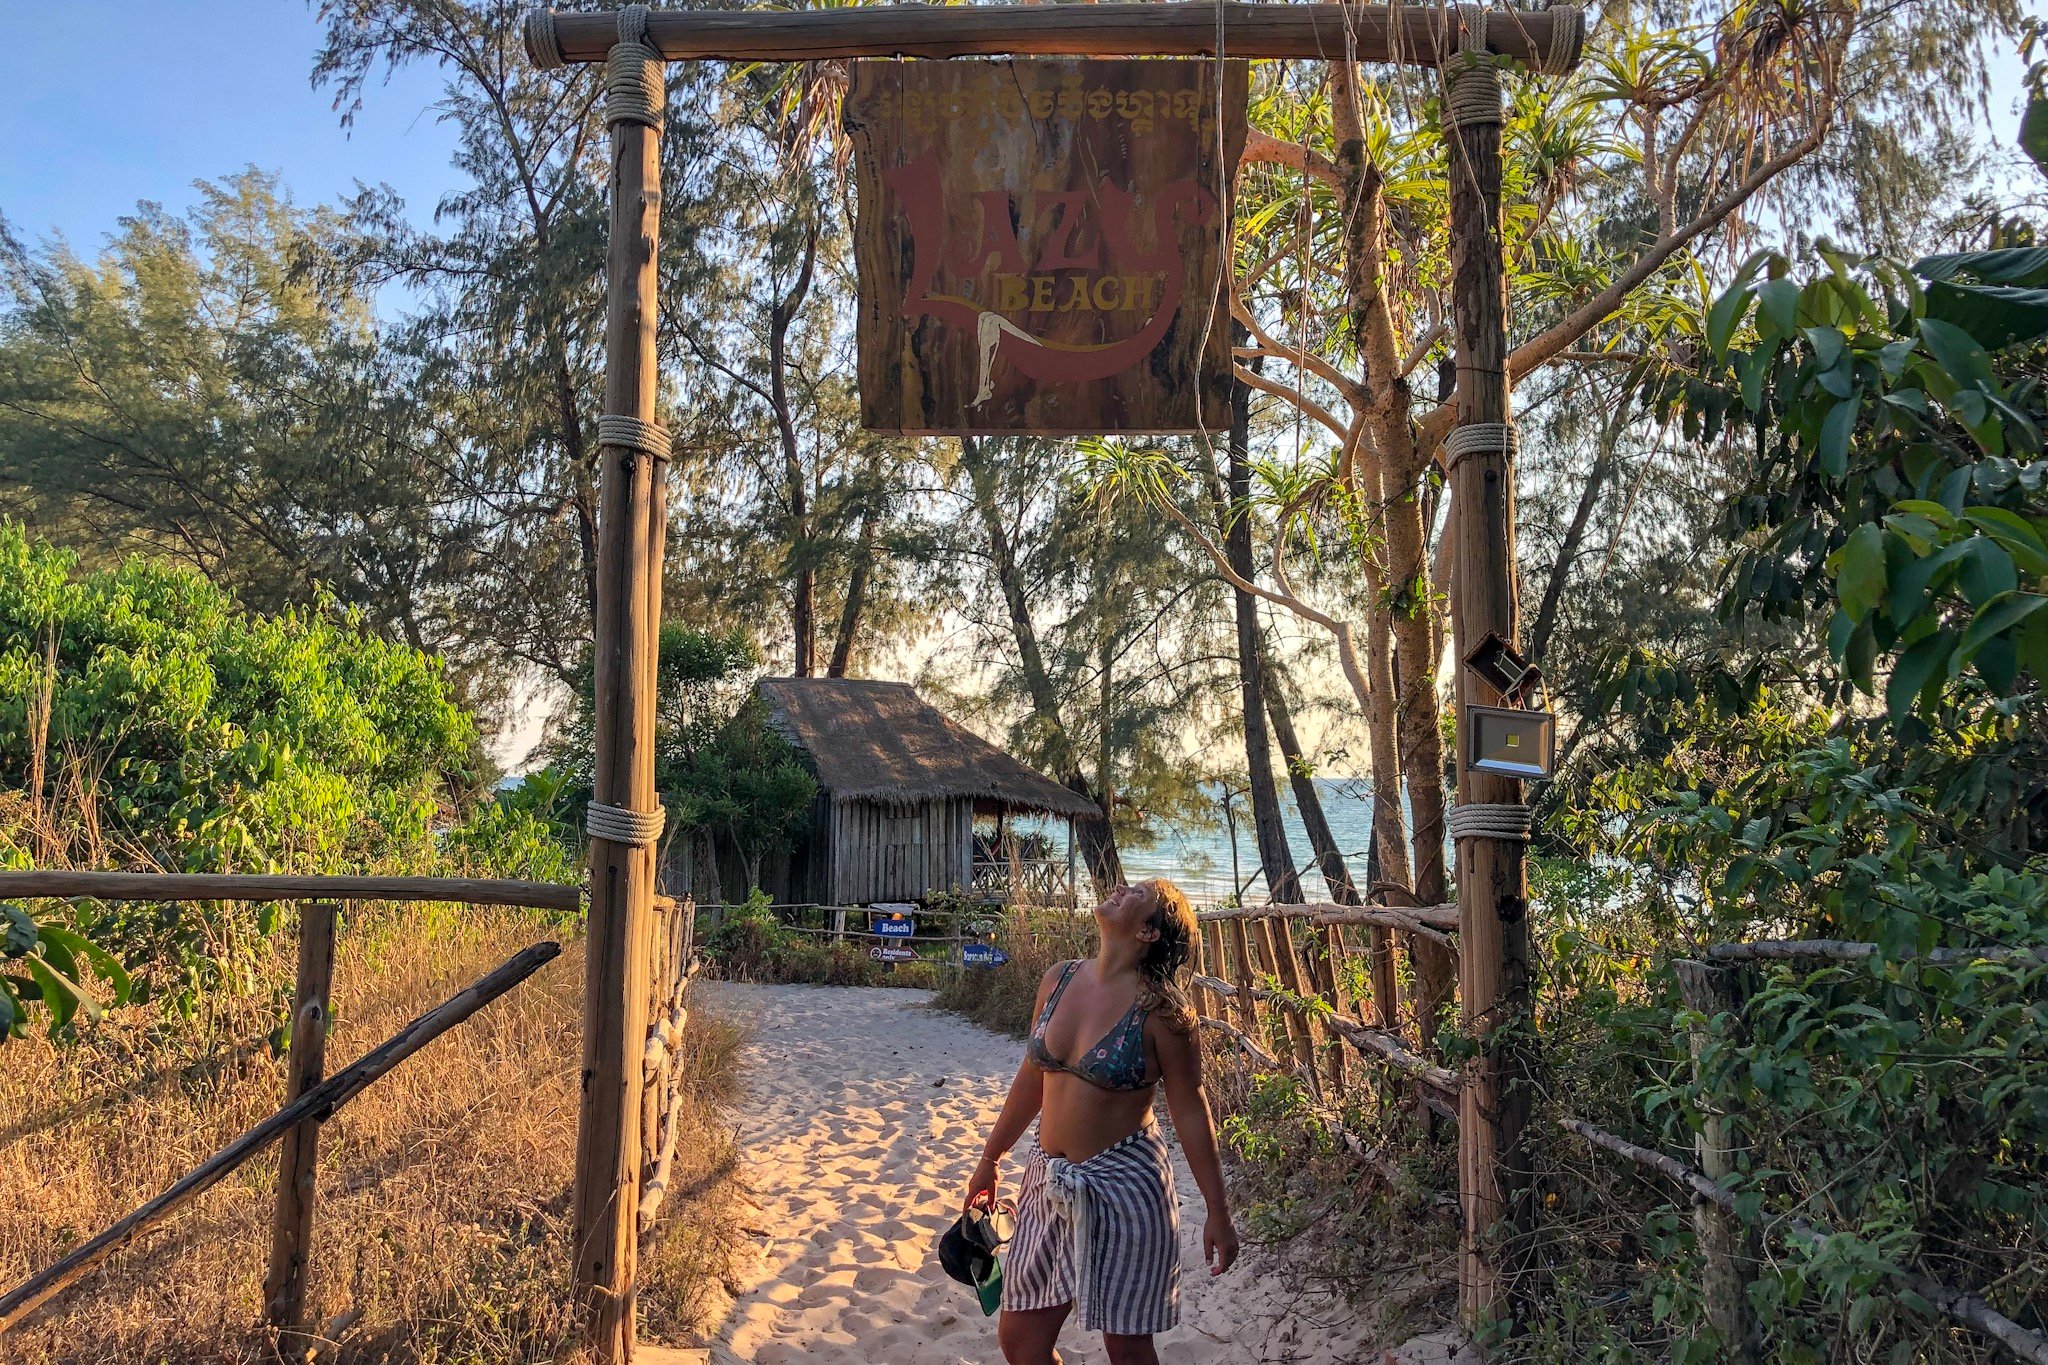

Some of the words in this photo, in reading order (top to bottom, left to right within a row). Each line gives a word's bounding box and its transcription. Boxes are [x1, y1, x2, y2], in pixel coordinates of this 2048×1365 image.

[881, 147, 1221, 383] LAZY
[998, 275, 1154, 313] BEACH
[881, 922, 910, 933] Beach
[882, 948, 912, 957] Residents
